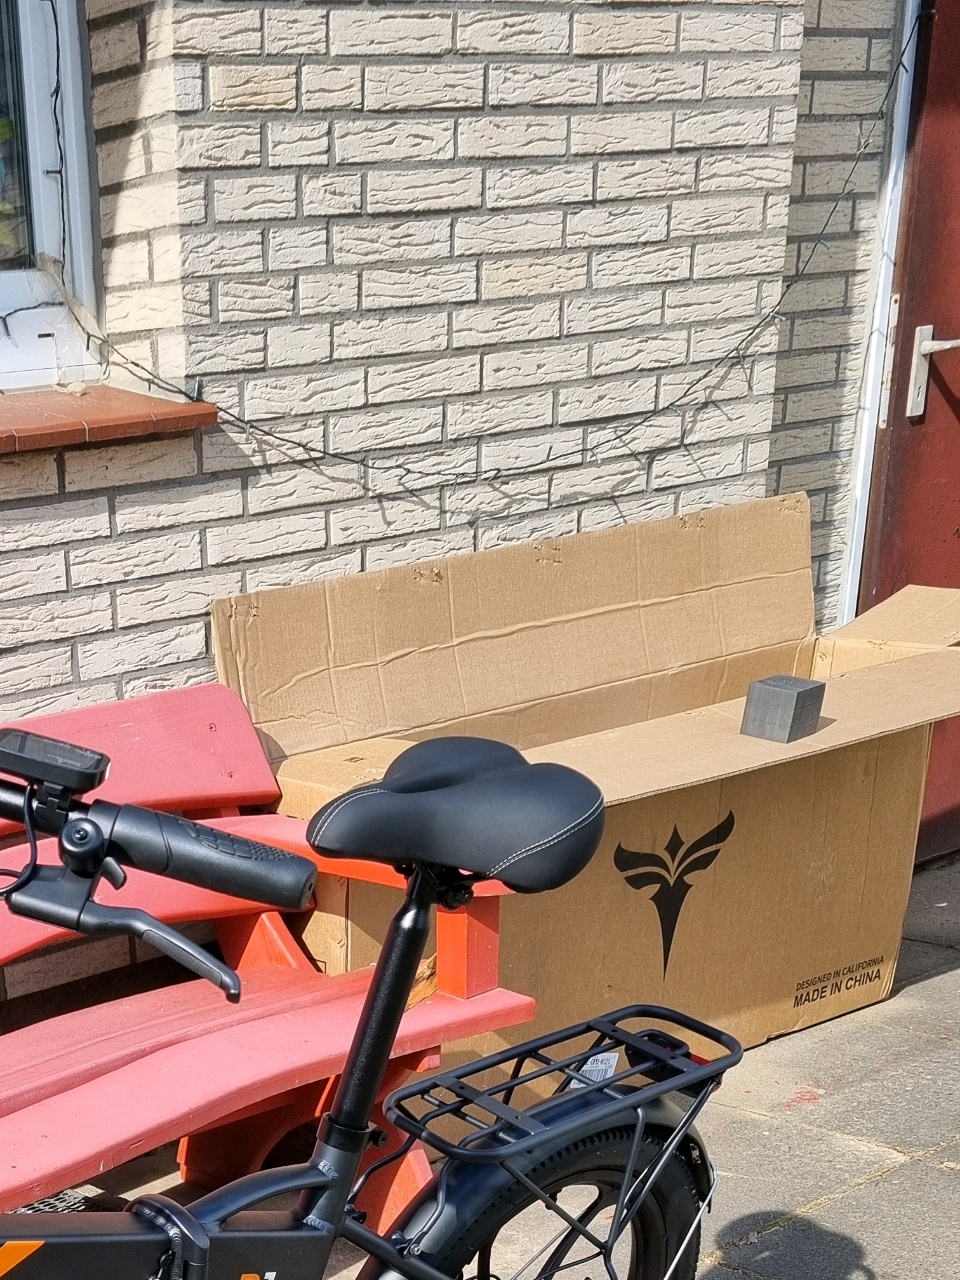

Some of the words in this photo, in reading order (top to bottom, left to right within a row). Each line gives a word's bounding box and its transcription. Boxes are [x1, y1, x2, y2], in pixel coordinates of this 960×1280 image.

[793, 985, 828, 1008] MADE
[829, 981, 843, 996] IN
[845, 968, 881, 990] CHINA
[796, 973, 832, 991] DESIGNED
[833, 969, 841, 979] IN
[842, 956, 884, 976] CALIFORNIA
